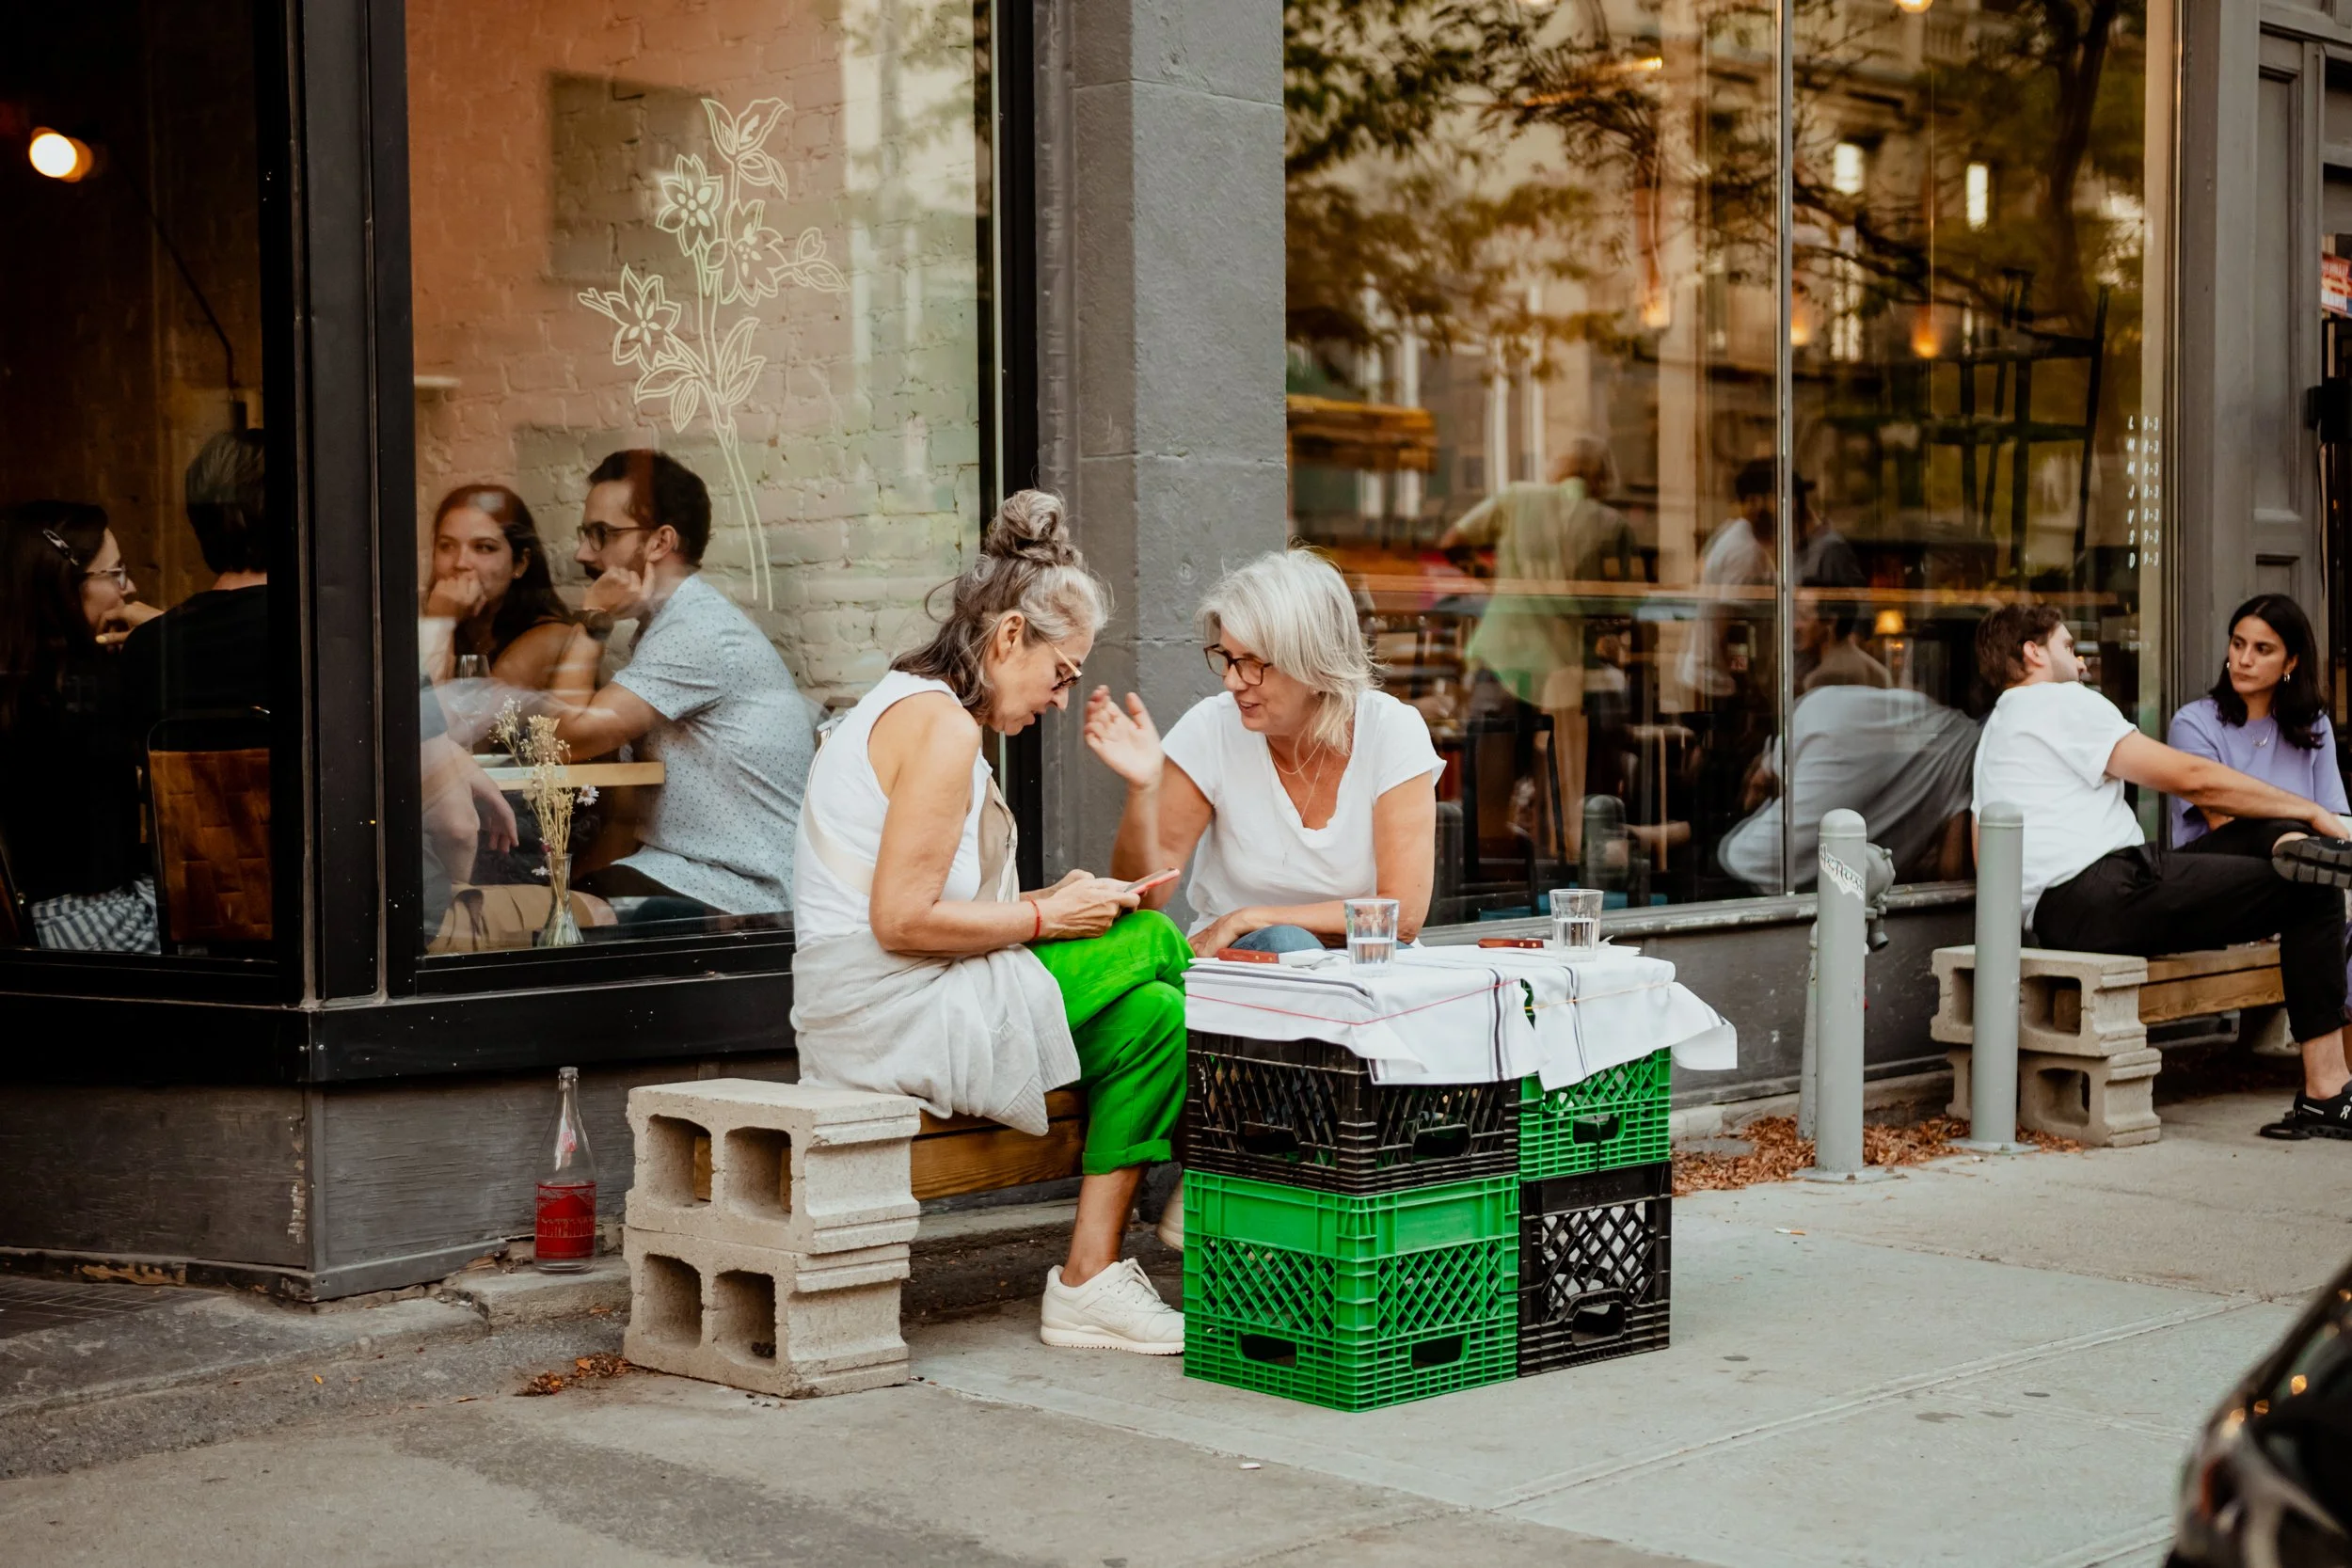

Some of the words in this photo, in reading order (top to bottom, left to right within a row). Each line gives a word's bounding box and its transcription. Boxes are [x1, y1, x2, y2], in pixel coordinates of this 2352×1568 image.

[2127, 437, 2136, 452] M
[2127, 461, 2136, 476] M
[2128, 530, 2136, 546] S
[2128, 552, 2136, 569] D
